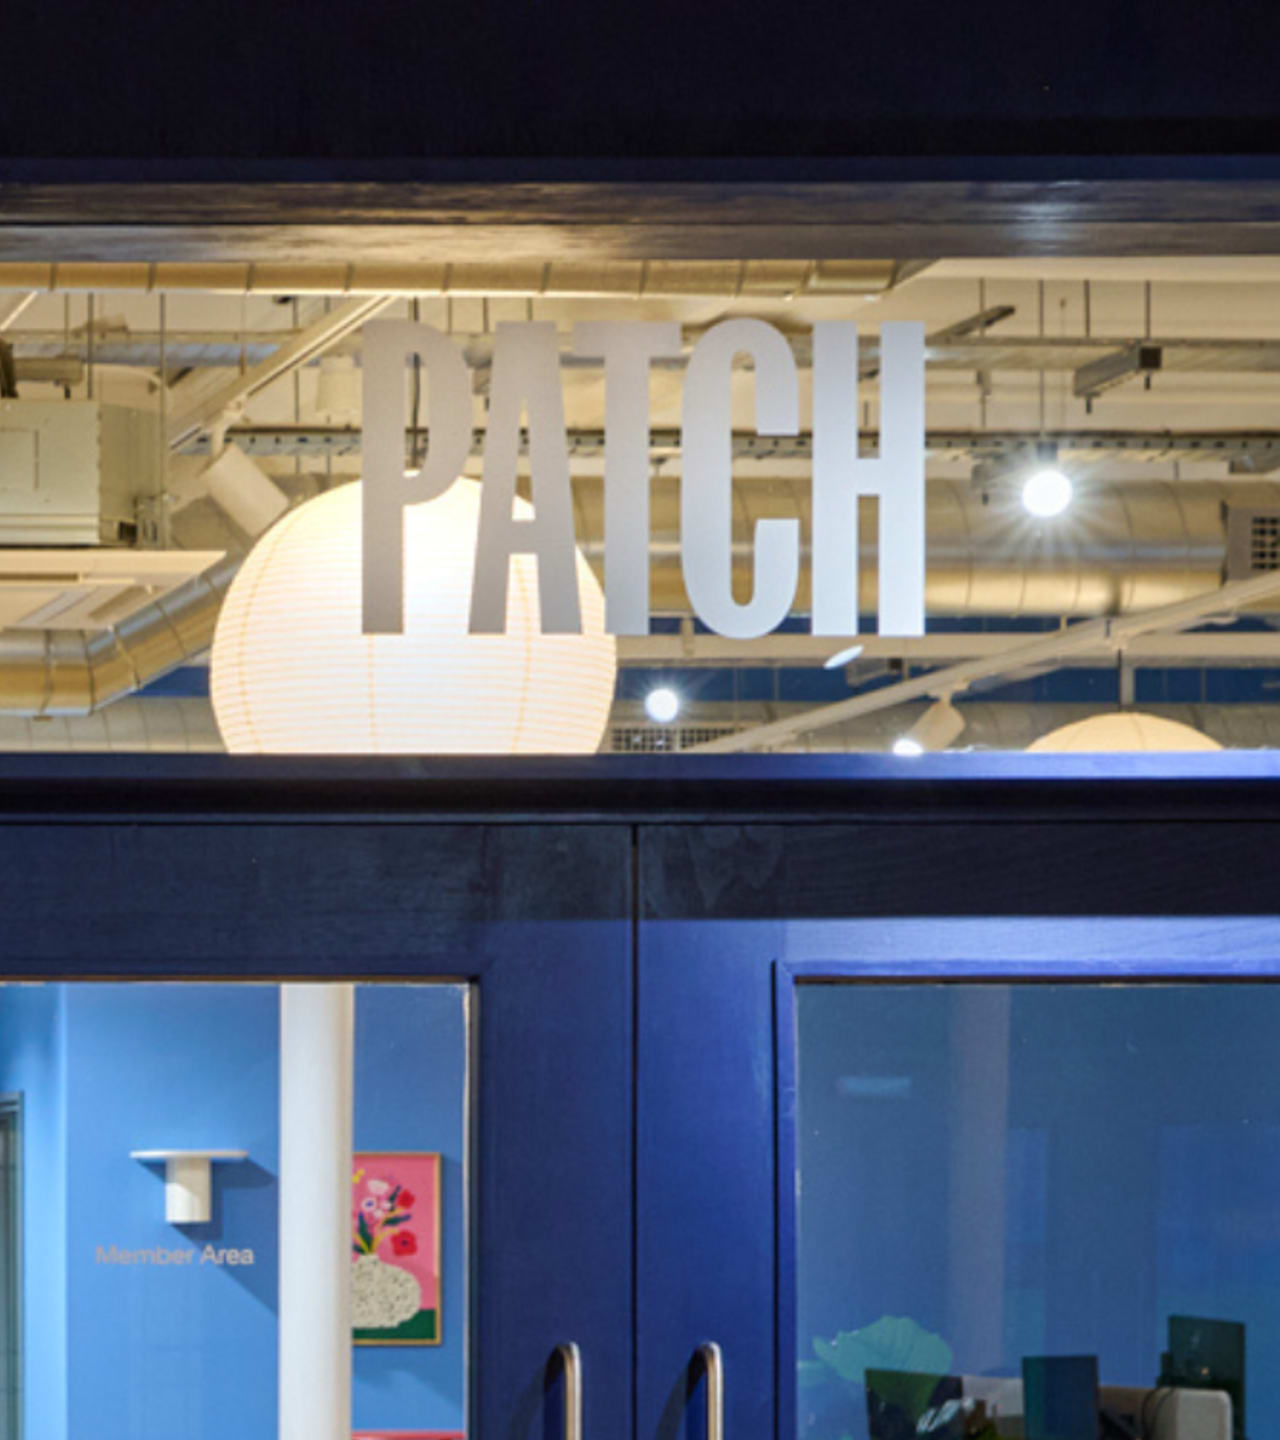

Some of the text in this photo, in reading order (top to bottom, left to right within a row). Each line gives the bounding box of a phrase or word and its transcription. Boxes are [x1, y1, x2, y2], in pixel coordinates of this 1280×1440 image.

[362, 317, 926, 639] PATCH
[96, 1243, 255, 1265] Member Area
